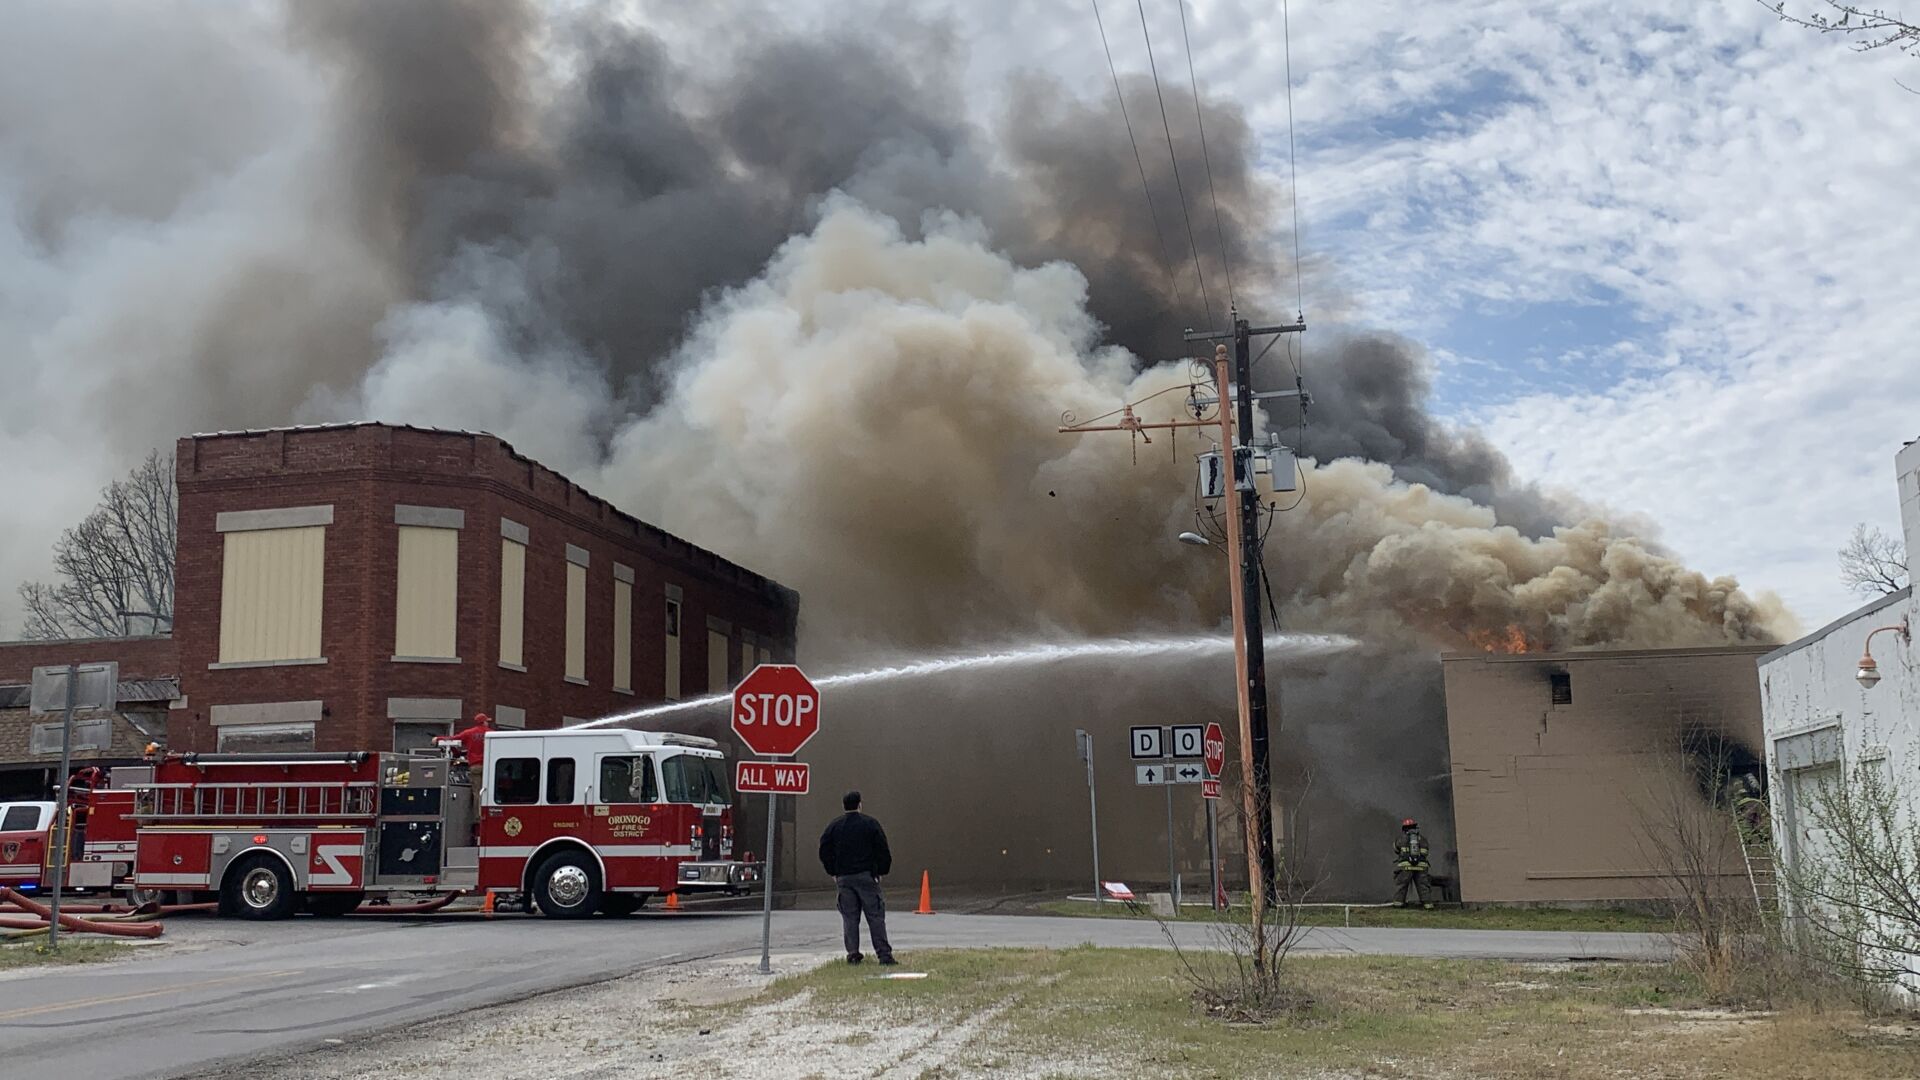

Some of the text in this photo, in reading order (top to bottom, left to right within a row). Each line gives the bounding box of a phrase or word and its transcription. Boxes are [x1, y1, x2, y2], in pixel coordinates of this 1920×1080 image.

[738, 693, 814, 727] STOP
[1141, 734, 1153, 751] D
[1182, 733, 1194, 750] O
[1206, 739, 1223, 760] STOP
[740, 768, 806, 787] ALL WAY
[1204, 783, 1215, 794] ALL
[608, 815, 650, 825] ORONOGO
